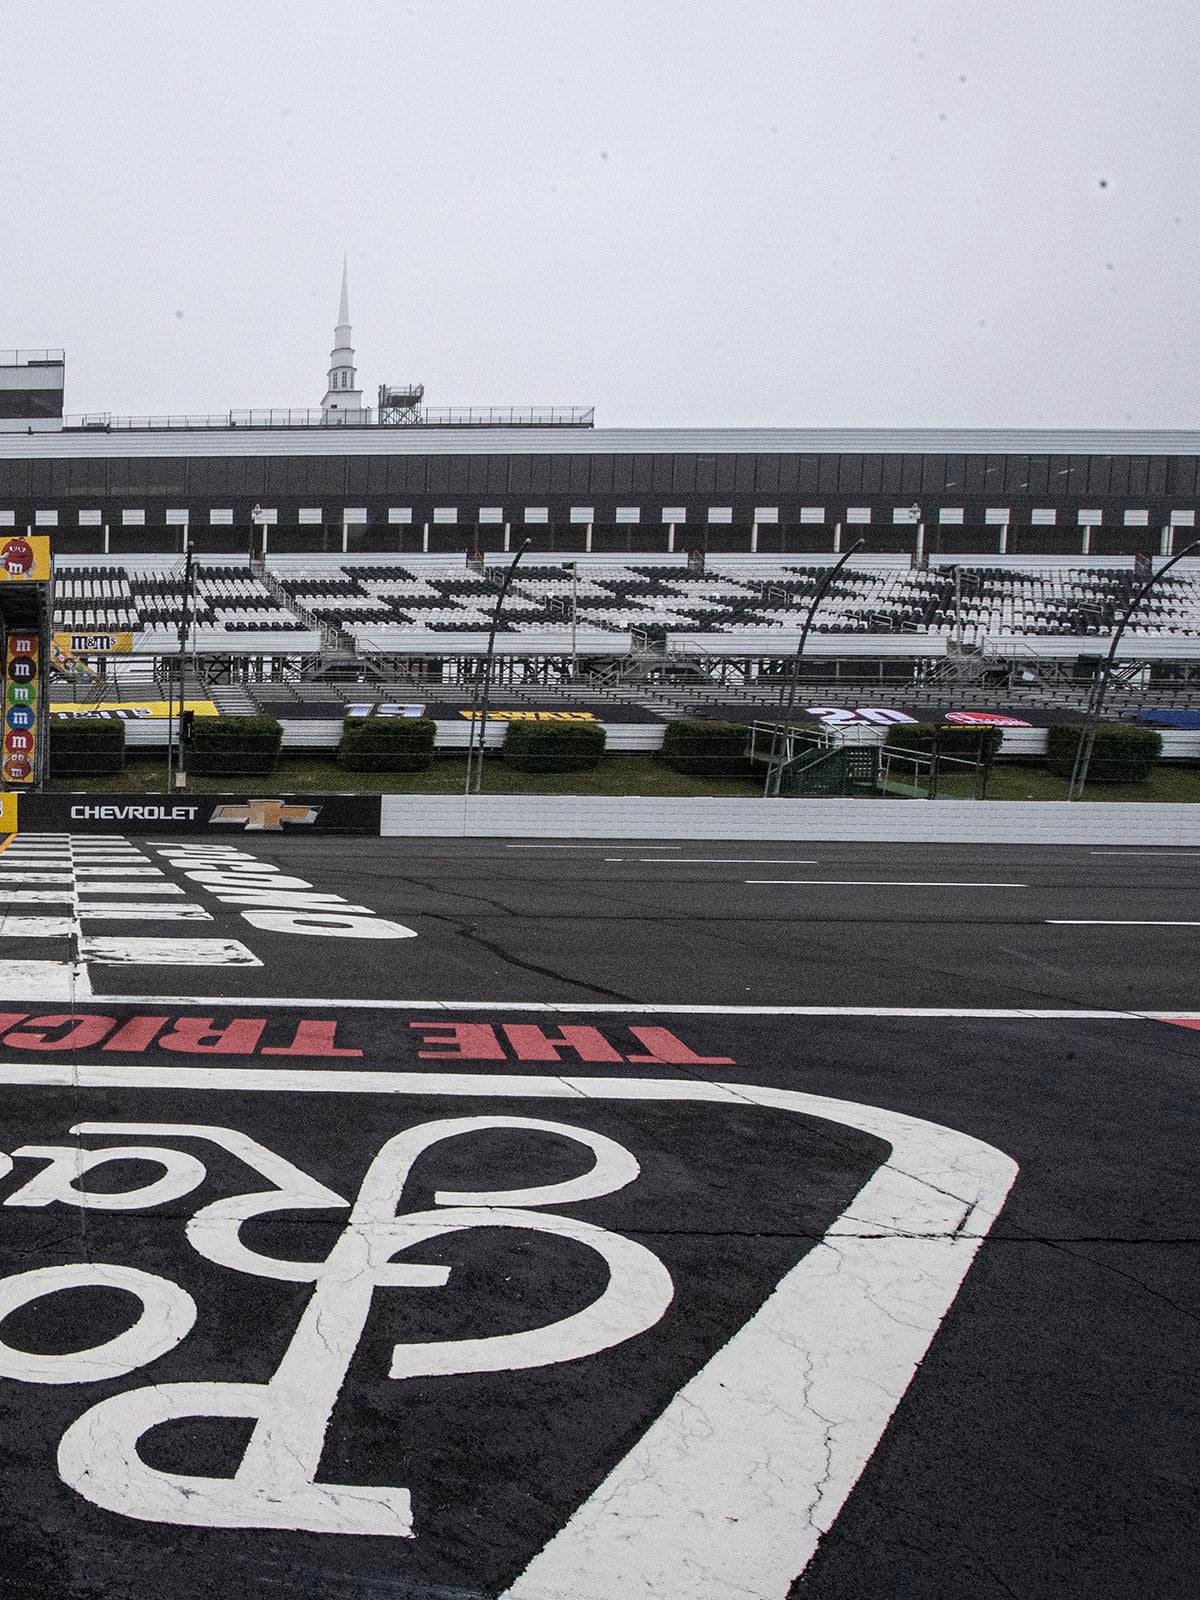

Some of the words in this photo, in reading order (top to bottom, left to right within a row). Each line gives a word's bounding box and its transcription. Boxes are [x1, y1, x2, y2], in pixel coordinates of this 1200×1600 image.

[8, 561, 24, 575] m
[16, 638, 31, 652] m
[14, 663, 30, 676] m
[13, 687, 29, 700] m
[344, 703, 427, 717] 19
[804, 707, 920, 725] 20
[13, 711, 28, 725] m
[11, 735, 27, 749] m
[70, 805, 199, 820] CHEVROLET
[145, 841, 420, 940] POCONO
[407, 1020, 738, 1066] THE
